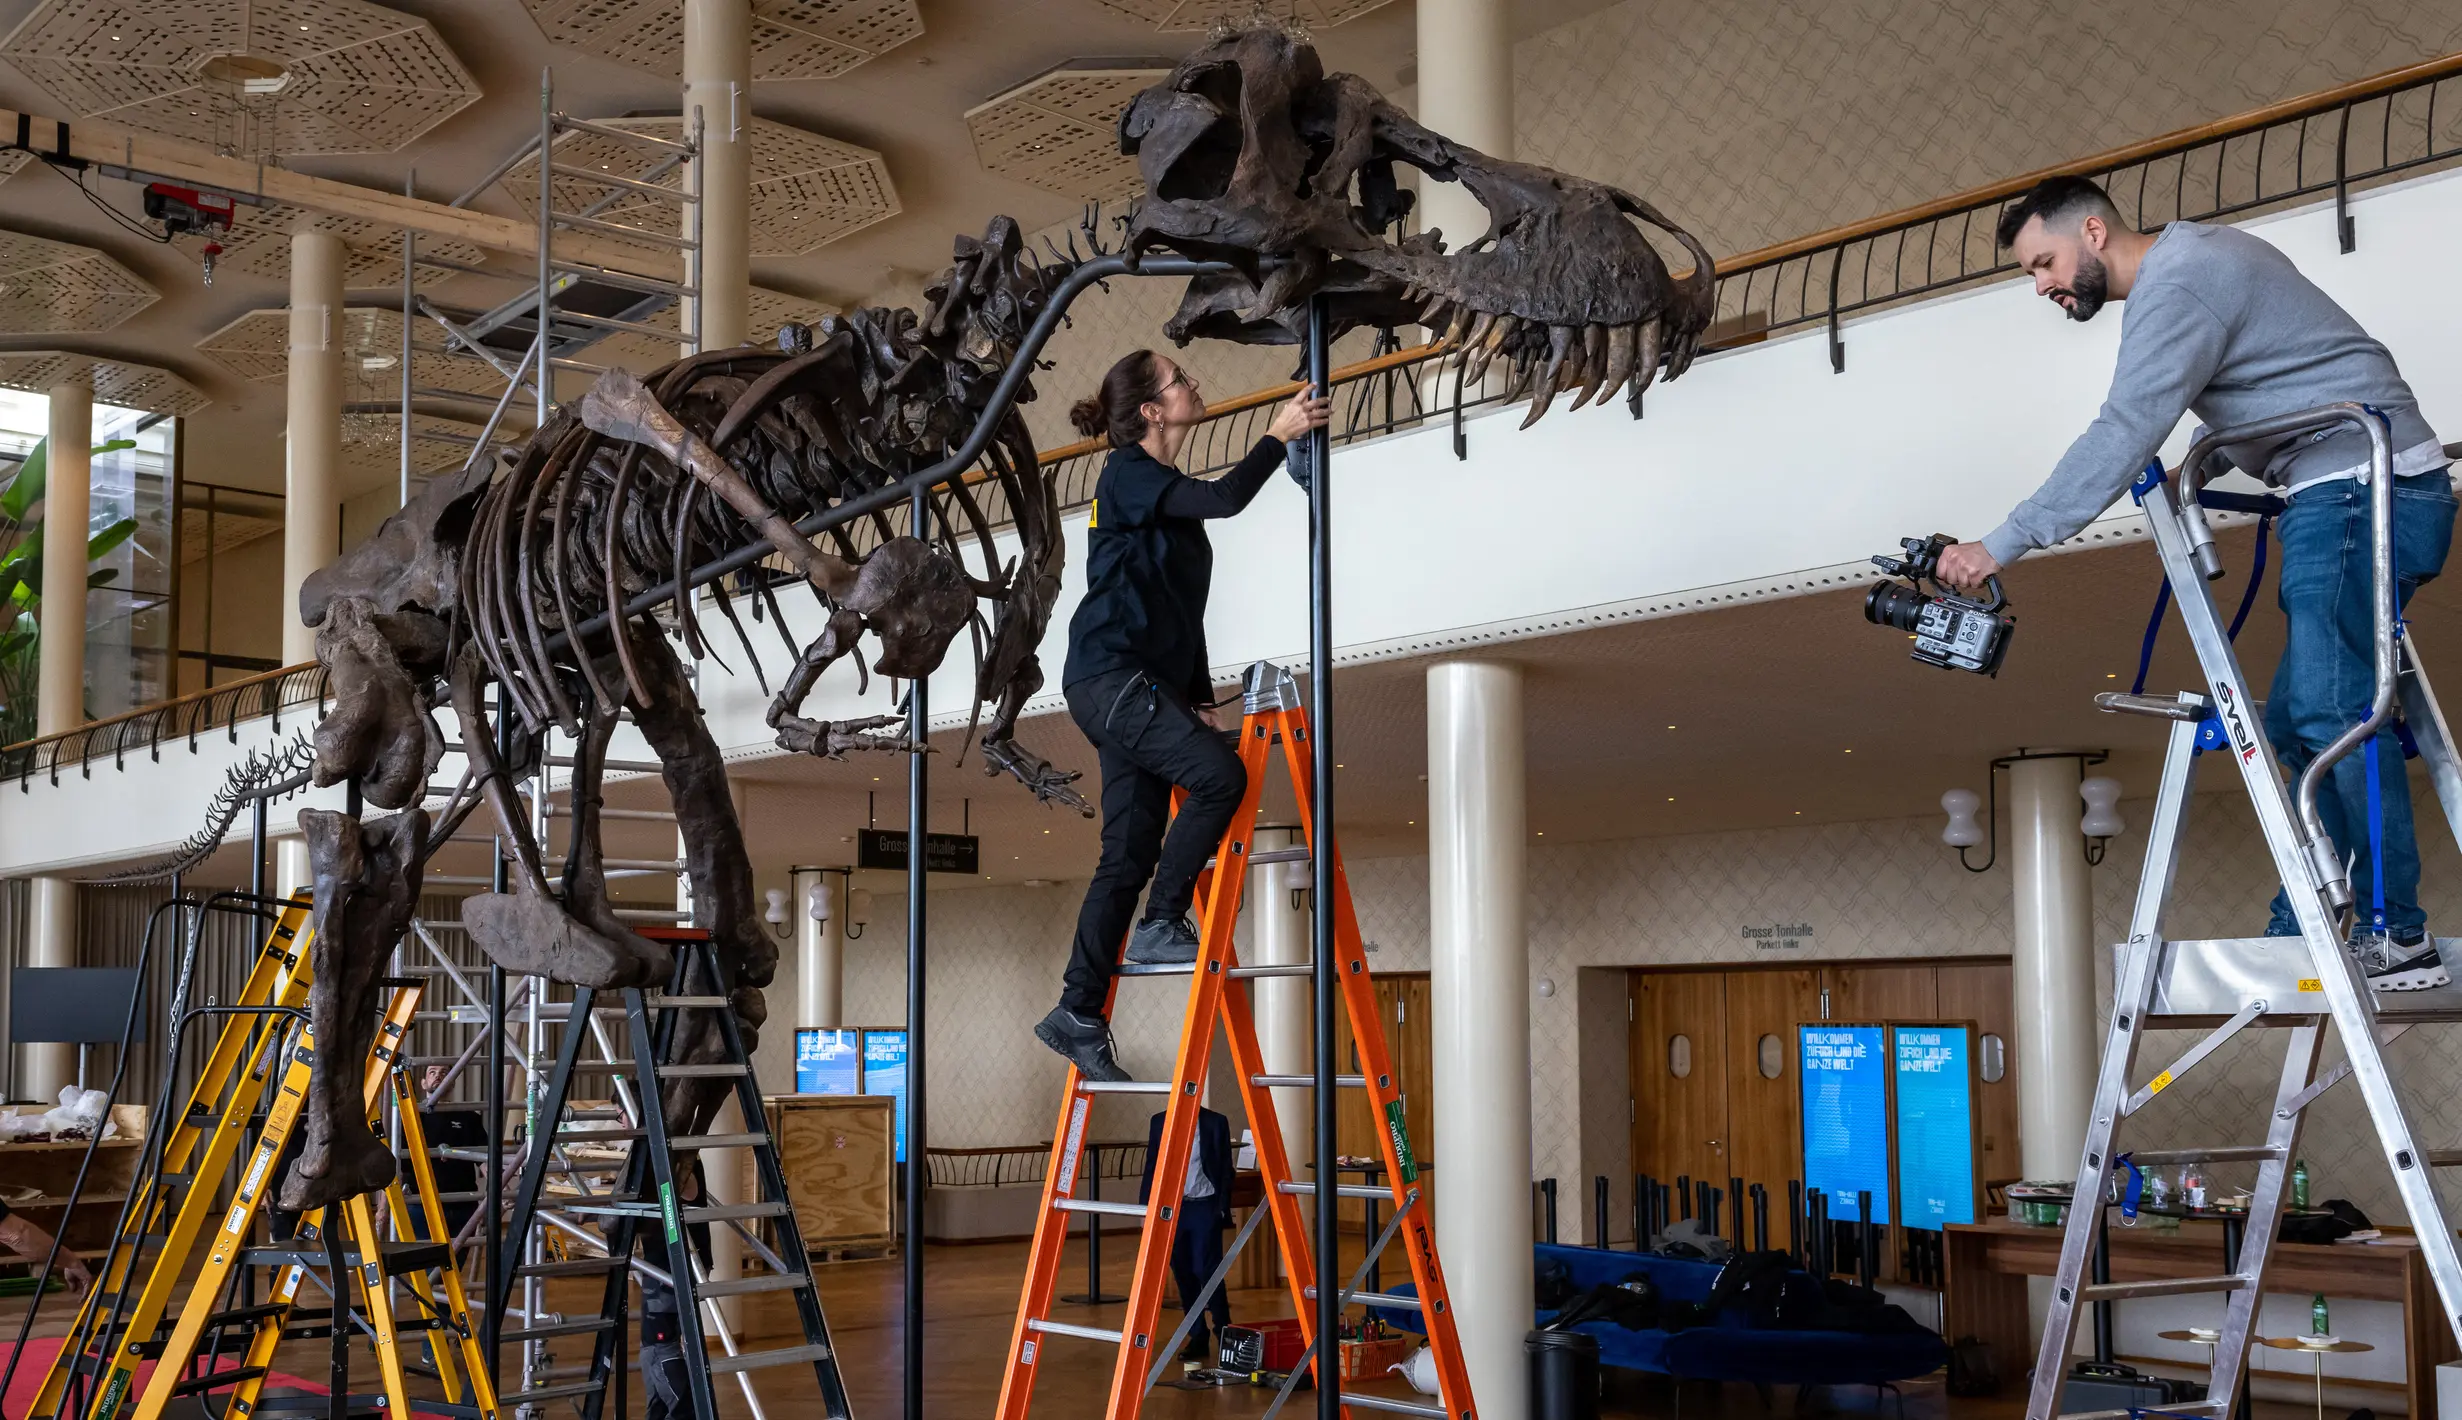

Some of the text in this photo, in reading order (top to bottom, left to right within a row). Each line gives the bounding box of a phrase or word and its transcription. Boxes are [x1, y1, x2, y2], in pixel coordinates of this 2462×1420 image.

[1968, 609, 1988, 618] SONY
[880, 836, 956, 855] Gross nhalle
[1742, 922, 1813, 939] Grosse Tonhalle
[1756, 939, 1781, 950] Parkett
[1806, 1033, 1854, 1045] WILLKOMMEN
[1834, 1046, 1852, 1058] UND
[1853, 1046, 1867, 1058] DIE
[1806, 1058, 1855, 1071] GANZE WELT
[1390, 1121, 1406, 1168] INDUPRO
[1415, 1225, 1438, 1283] svel
[100, 1380, 118, 1414] INDUPRO
